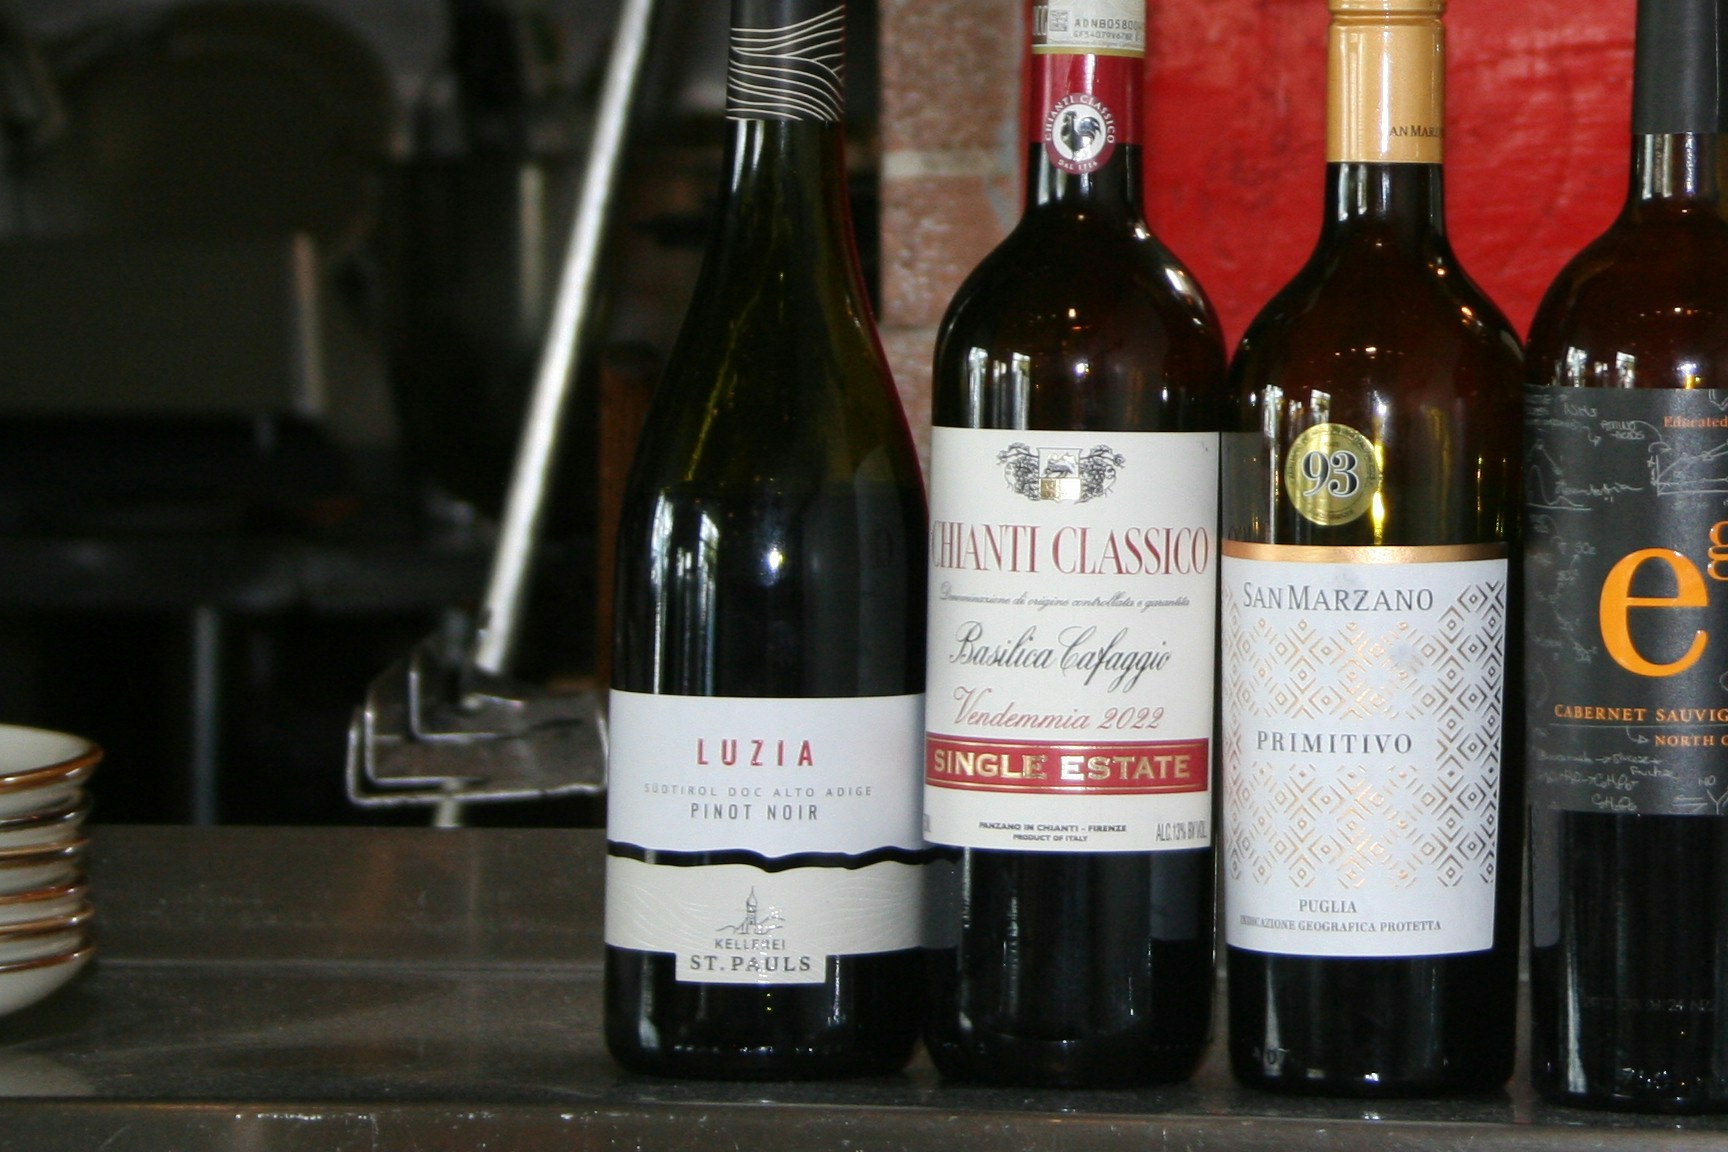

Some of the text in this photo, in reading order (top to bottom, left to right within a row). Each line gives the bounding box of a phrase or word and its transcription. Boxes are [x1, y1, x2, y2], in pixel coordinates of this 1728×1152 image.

[1080, 95, 1115, 143] CLASSICO
[1389, 126, 1407, 136] AN
[1663, 415, 1728, 428] Educated
[1302, 450, 1359, 497] 93
[930, 520, 1209, 575] CHIANTI CLASSICO
[1013, 591, 1028, 605] di
[1028, 596, 1070, 612] origine
[1072, 591, 1134, 607] controllata
[950, 620, 1171, 693] Basilica Cafaggio
[953, 686, 1165, 730] Vendemmia 2022
[1554, 704, 1647, 721] CABERNET
[1257, 731, 1413, 754] PRIMITIVO
[1654, 735, 1714, 746] NORTH
[697, 738, 814, 766] LUZIA
[934, 749, 1191, 781] SINGLE ESTATE
[643, 782, 872, 797] SÜDTIROL DOC ALTO ADIGE
[691, 803, 818, 820] PINOT NOIR
[979, 821, 1021, 832] PANZANO
[1024, 822, 1034, 831] IN
[1037, 823, 1079, 832] CHIANTI
[1087, 823, 1126, 833] FIRENZE
[1013, 834, 1088, 842] PRODUCT OF ITALY
[1299, 899, 1357, 913] PUGLIA
[1240, 915, 1442, 932] INDICAZIONE GEOGRAFICA PROTETTA
[714, 938, 786, 950] KELLEREI
[690, 955, 811, 972] ST. PAULS
